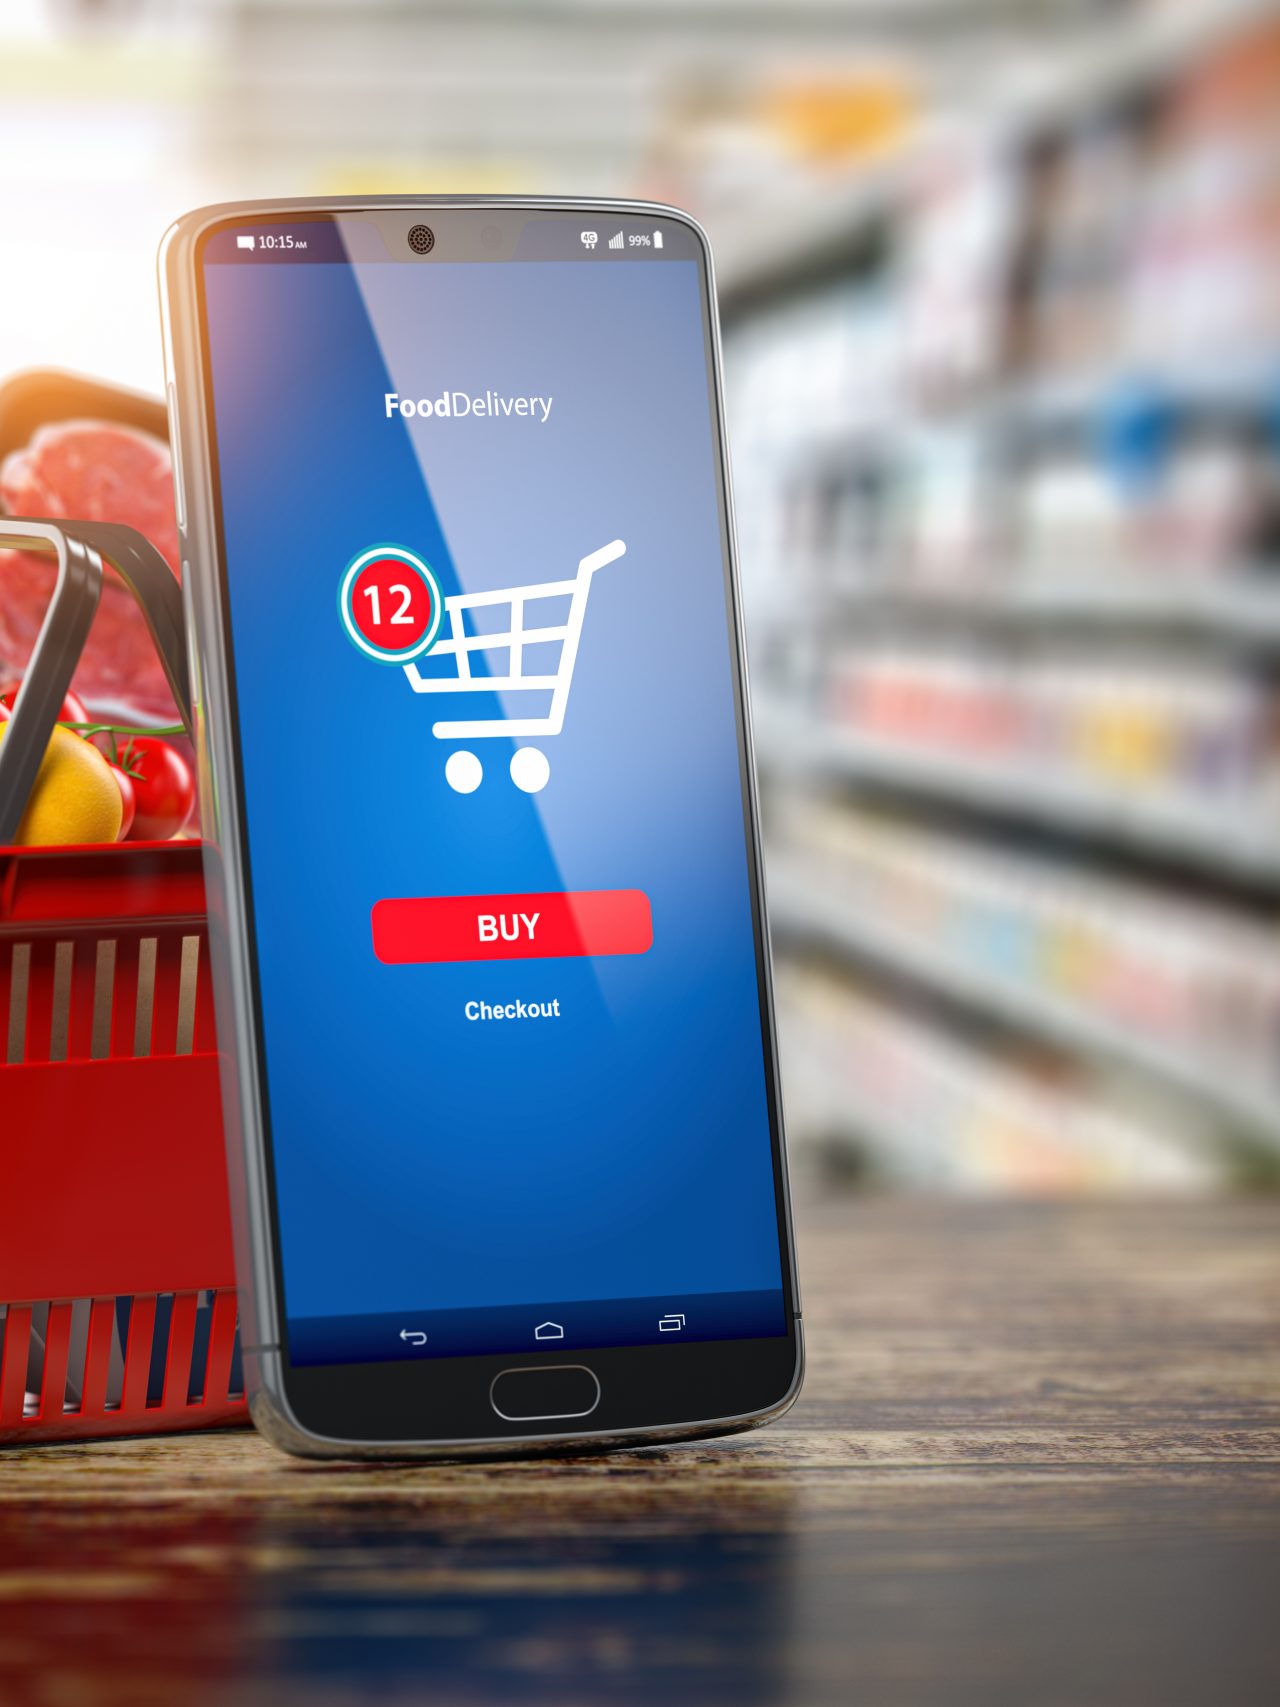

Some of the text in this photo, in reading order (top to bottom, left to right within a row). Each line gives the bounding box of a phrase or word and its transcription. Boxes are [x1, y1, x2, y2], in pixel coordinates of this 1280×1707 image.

[258, 235, 308, 249] 10:15 AM
[628, 234, 651, 247] 99%
[384, 390, 553, 423] FoodDelivery
[363, 583, 415, 625] 12
[477, 912, 541, 942] BUY
[464, 998, 561, 1021] Checkout
